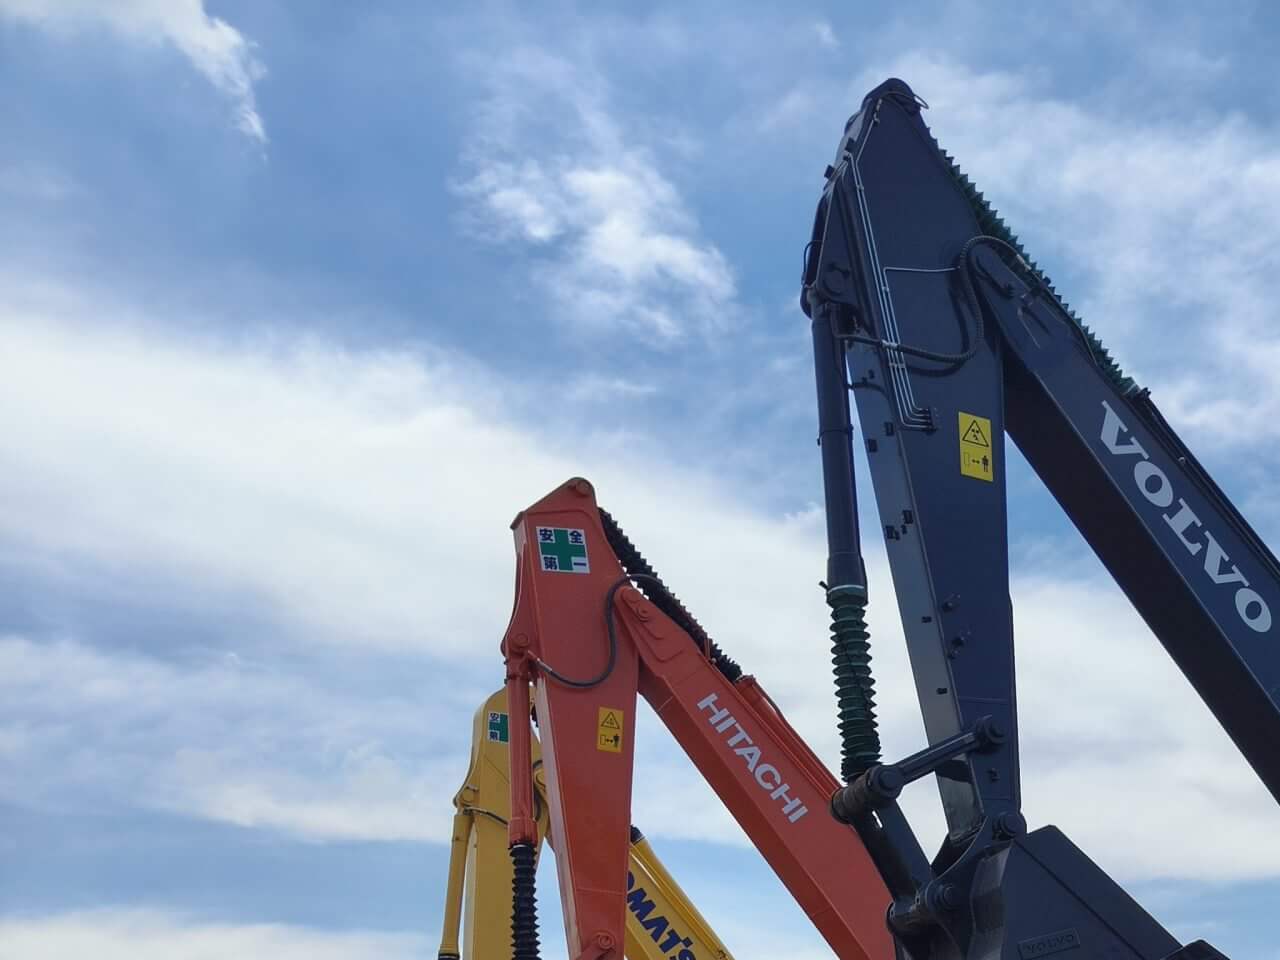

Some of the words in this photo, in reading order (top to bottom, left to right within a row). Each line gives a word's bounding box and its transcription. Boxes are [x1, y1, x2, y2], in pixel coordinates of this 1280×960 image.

[539, 528, 583, 544] 安全
[1101, 401, 1272, 634] VOLVO
[697, 693, 809, 824] HITACHI
